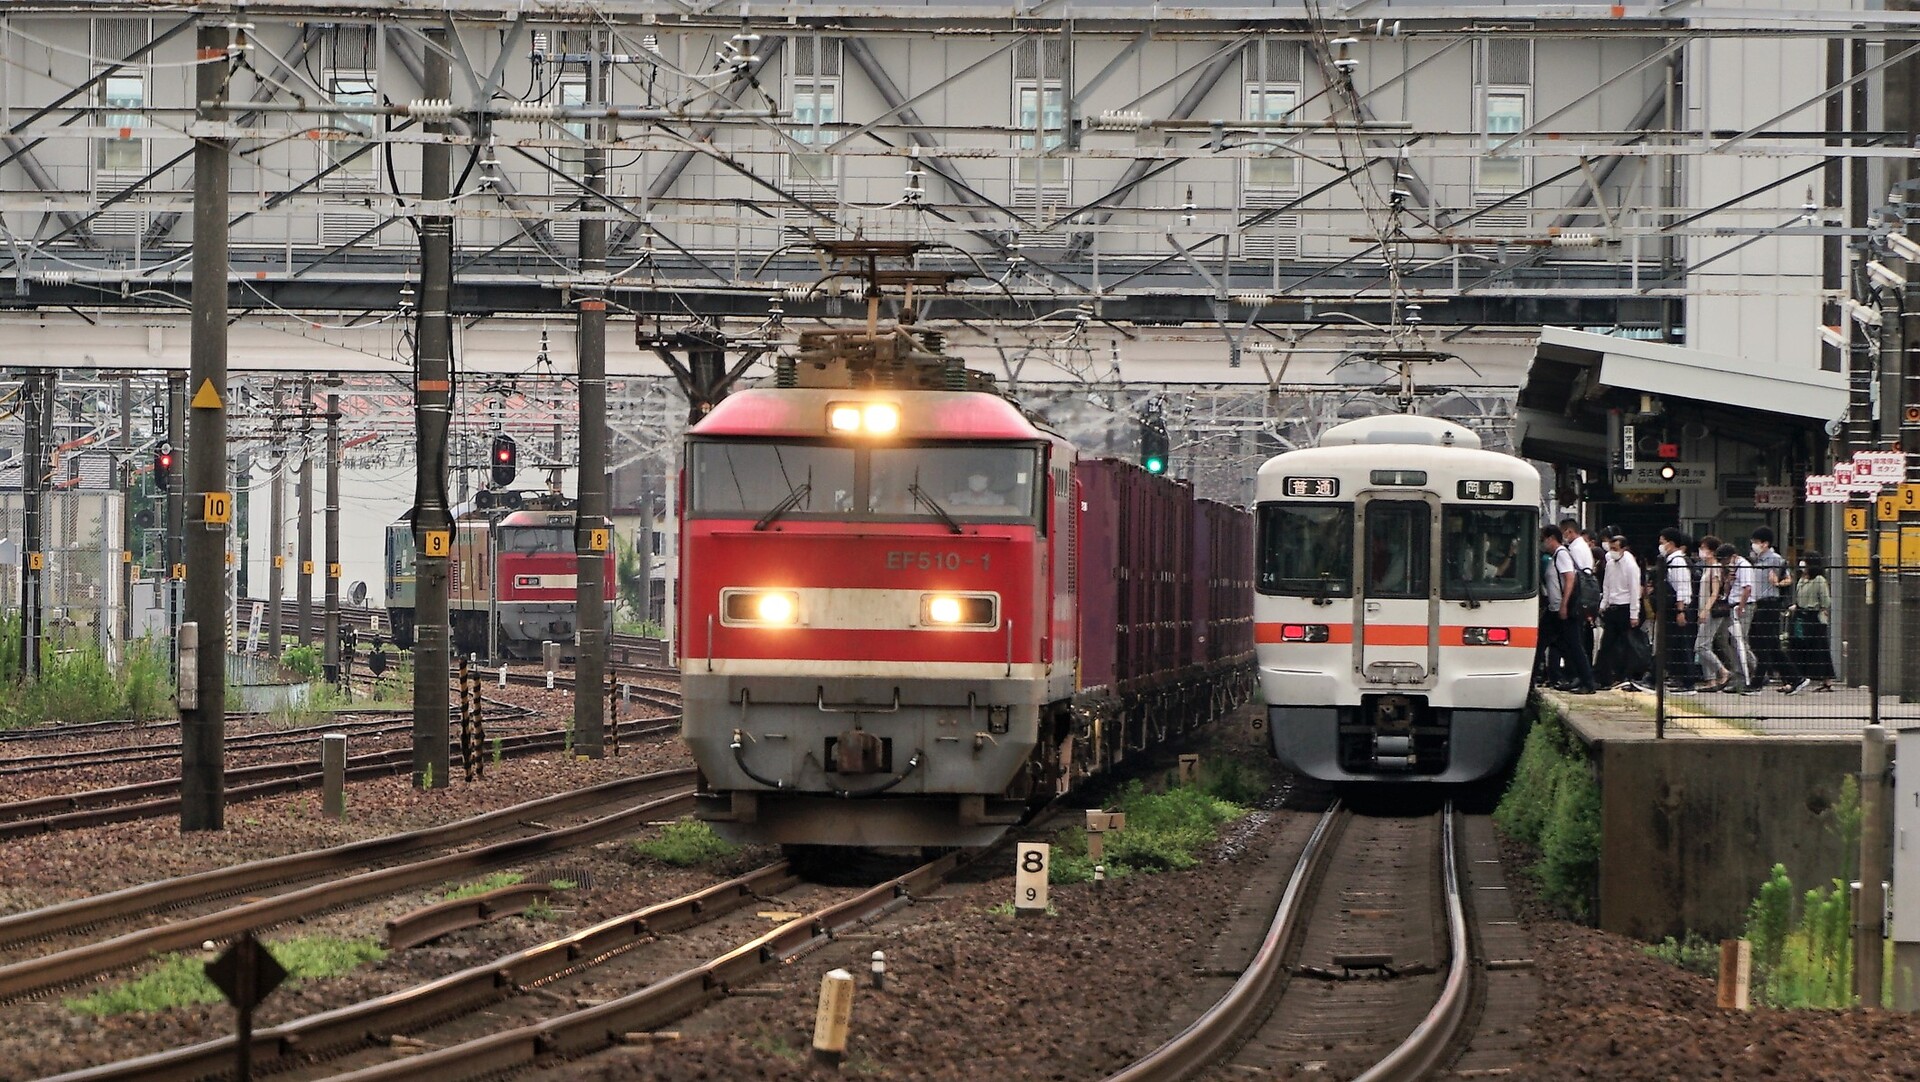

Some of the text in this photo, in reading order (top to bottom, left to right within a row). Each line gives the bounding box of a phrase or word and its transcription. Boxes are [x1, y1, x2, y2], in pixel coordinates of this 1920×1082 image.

[1293, 480, 1331, 495] 普通
[1466, 481, 1503, 495] 岡崎
[1905, 489, 1913, 505] 9
[210, 500, 224, 516] 10
[1884, 501, 1891, 516] 9
[1851, 514, 1858, 527] 8
[433, 537, 441, 551] 9
[596, 533, 603, 546] 8
[34, 557, 39, 566] 5
[886, 552, 992, 571] EF510-1
[176, 566, 183, 577] 5
[1252, 718, 1263, 730] 6
[1182, 758, 1197, 774] 7
[1021, 850, 1044, 873] 8
[1026, 887, 1036, 901] 9
